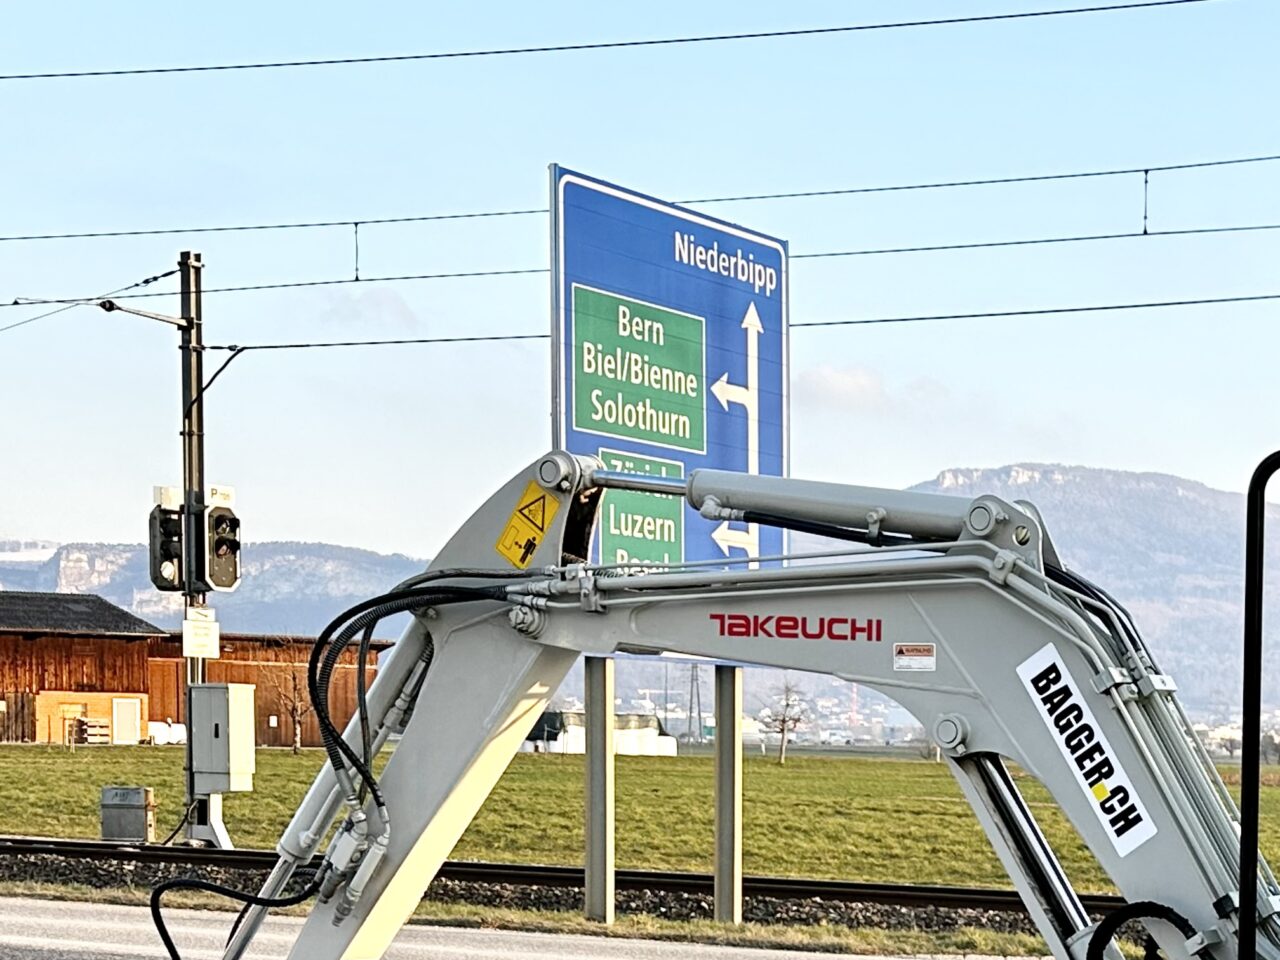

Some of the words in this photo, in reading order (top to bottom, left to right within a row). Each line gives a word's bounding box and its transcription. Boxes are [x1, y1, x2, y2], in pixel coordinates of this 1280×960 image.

[675, 231, 777, 297] Niederbipp
[618, 305, 664, 346] Bern
[583, 341, 698, 398] Biel/Bienne
[591, 389, 690, 440] Solothurn
[609, 504, 676, 543] Luzern
